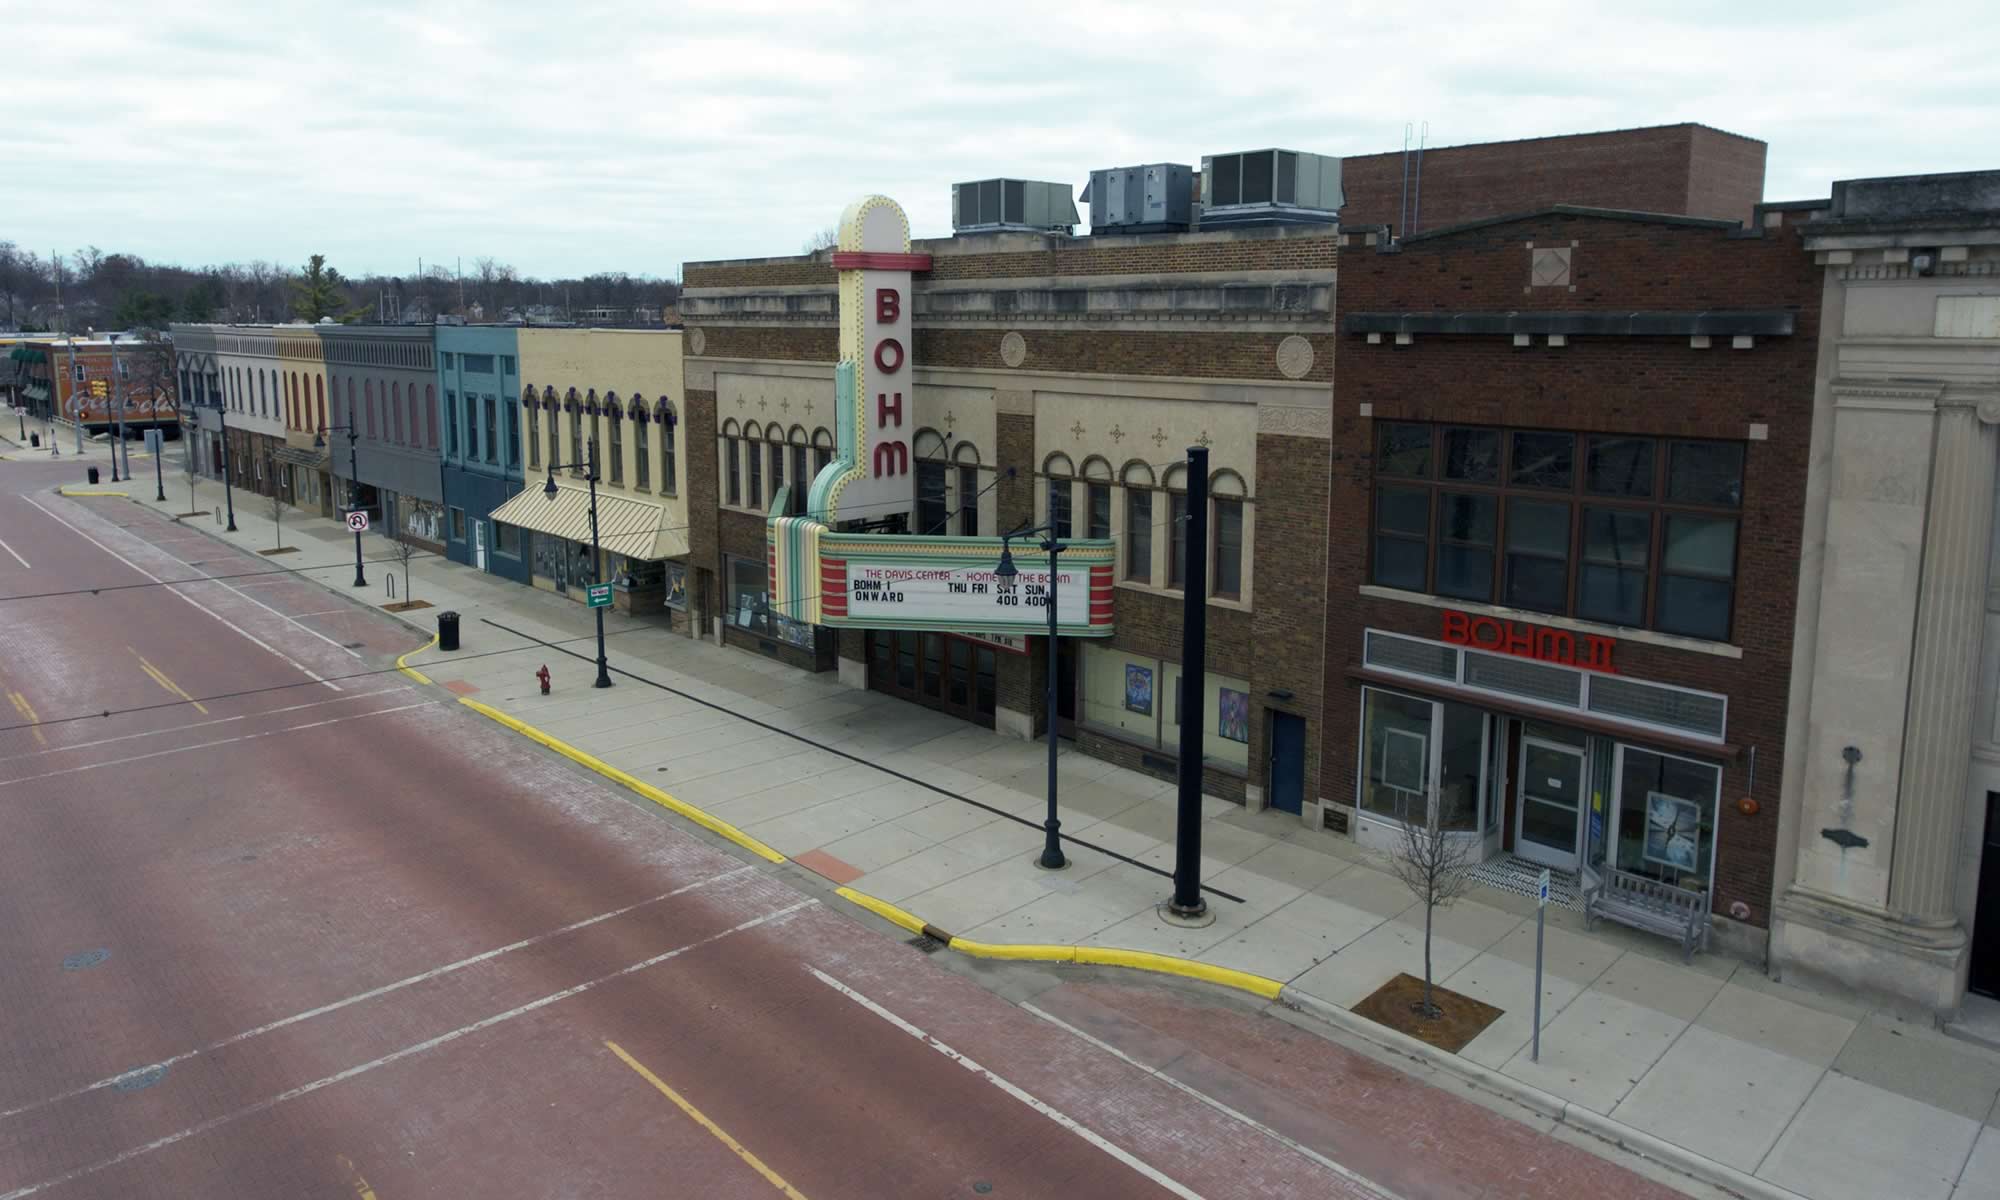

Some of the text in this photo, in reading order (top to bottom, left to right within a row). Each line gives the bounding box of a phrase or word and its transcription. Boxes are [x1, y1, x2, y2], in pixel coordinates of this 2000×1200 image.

[874, 288, 908, 479] BOHM
[865, 569, 882, 579] THE
[885, 570, 913, 580] DAVIS
[916, 571, 951, 581] CENTER
[967, 572, 998, 582] HOME
[1018, 573, 1037, 583] THE
[854, 580, 881, 591] BOHM
[948, 582, 967, 593] THU
[972, 583, 988, 594] FRI
[1025, 584, 1045, 595] SUN
[855, 591, 904, 602] ONWARD
[996, 595, 1046, 607] 400 400
[1441, 608, 1617, 673] BOHM II
